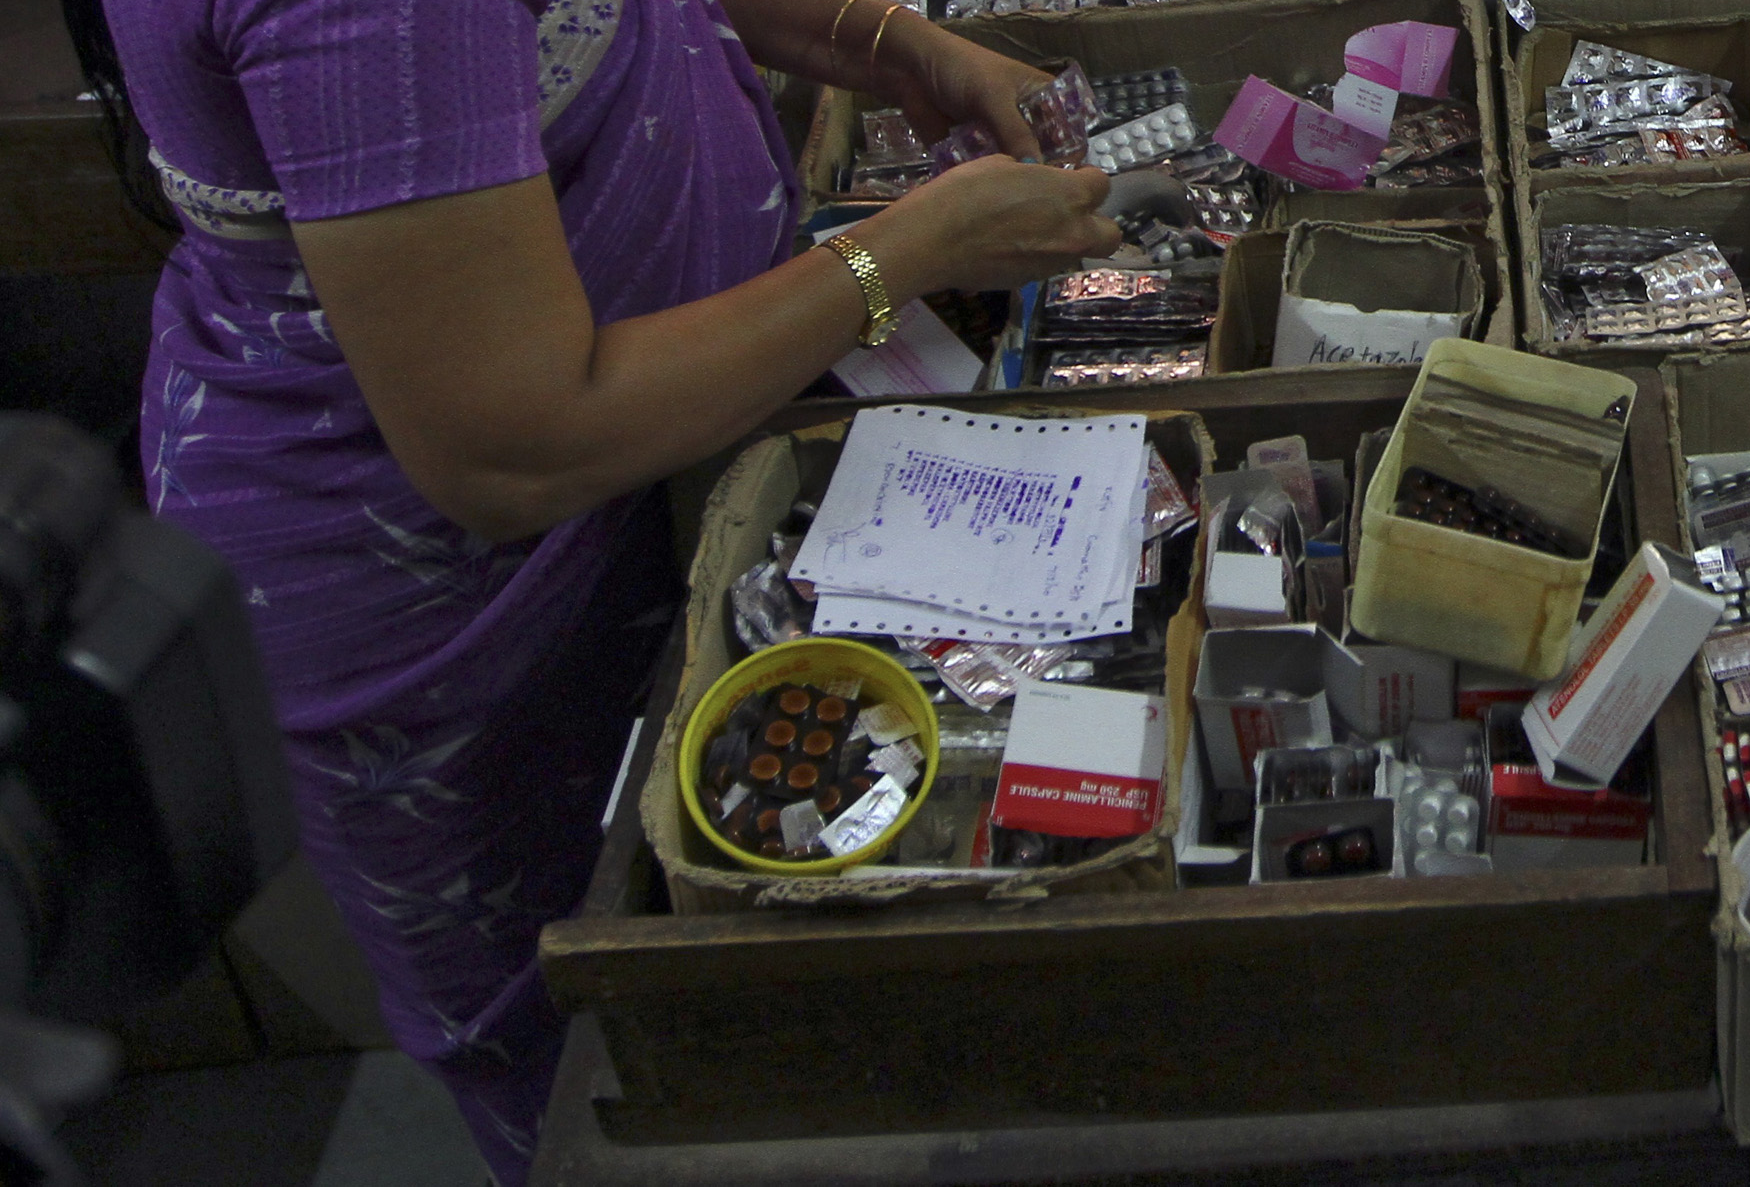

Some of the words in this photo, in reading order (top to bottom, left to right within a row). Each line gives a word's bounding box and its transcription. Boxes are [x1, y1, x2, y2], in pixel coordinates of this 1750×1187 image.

[1548, 664, 1589, 715] ATENOLOL
[1008, 785, 1060, 800] CAPSULE
[1080, 781, 1097, 793] mg
[1100, 785, 1120, 796] 250
[1062, 791, 1147, 810] PENICILLAMINE
[1126, 789, 1149, 800] USP
